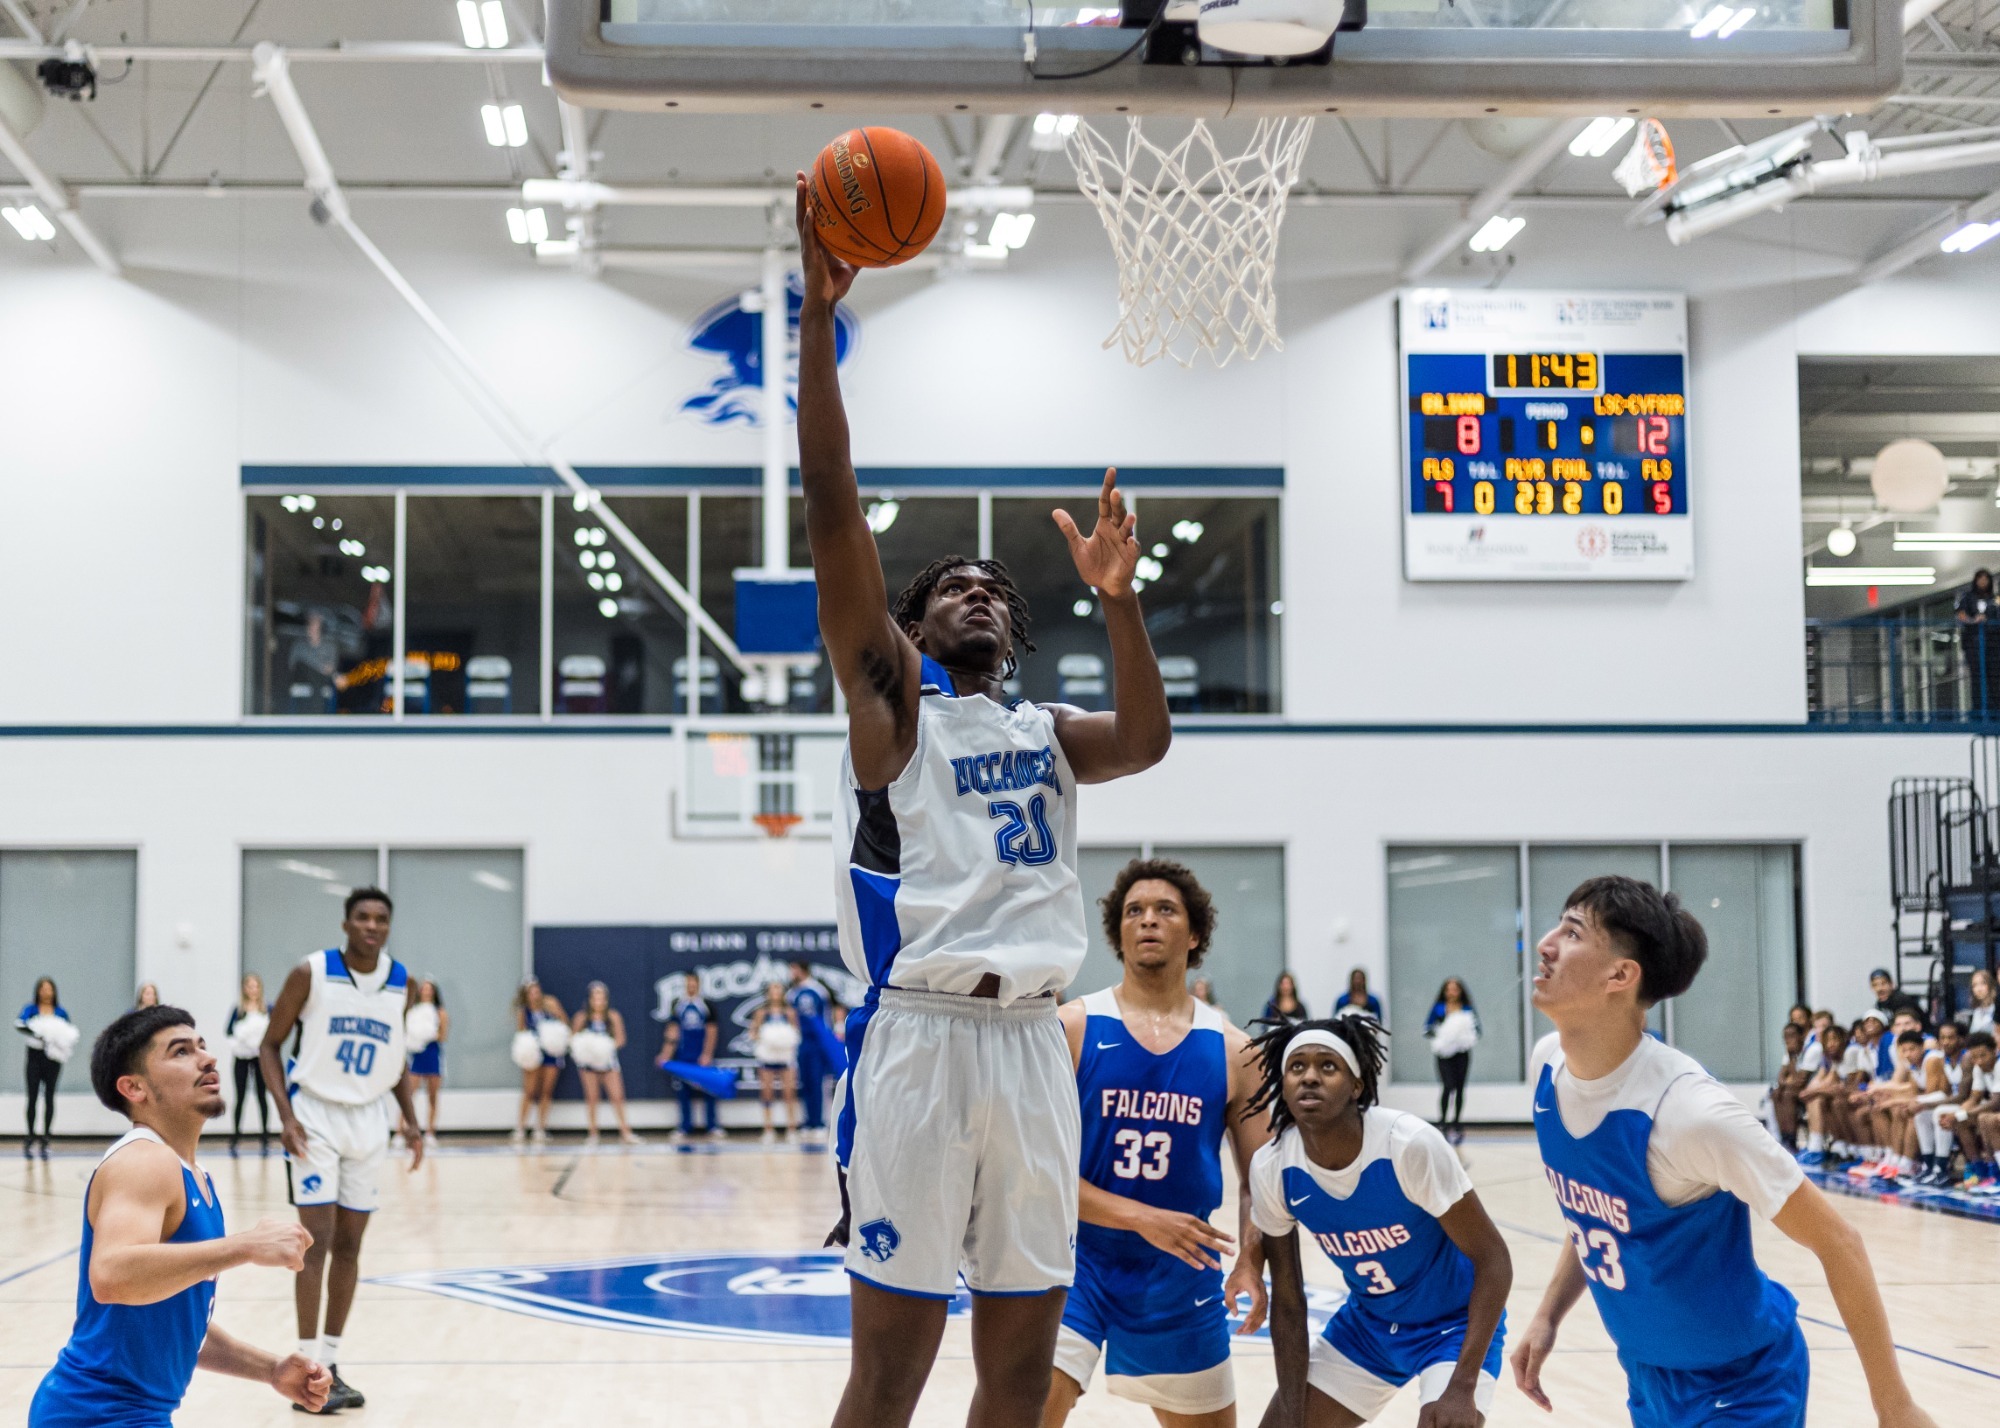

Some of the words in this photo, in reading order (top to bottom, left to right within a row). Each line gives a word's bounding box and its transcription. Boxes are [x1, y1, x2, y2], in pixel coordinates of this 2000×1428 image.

[1507, 352, 1597, 390] 11:43
[1457, 415, 1480, 455] 8
[1547, 420, 1557, 450] 1
[1637, 416, 1670, 455] 12
[1422, 457, 1455, 481] FLS
[1505, 457, 1545, 481] PLYR
[1552, 457, 1592, 481] FOUL
[1641, 457, 1673, 481] FLS
[1435, 481, 1454, 513] 7
[1474, 481, 1495, 515] 0
[1514, 481, 1554, 515] 23
[1562, 481, 1582, 515] 2
[1603, 481, 1623, 515] 0
[1652, 481, 1672, 514] 5
[670, 931, 747, 952] BLINN
[335, 1039, 376, 1076] 40
[1101, 1088, 1203, 1126] FALCONS
[1113, 1128, 1172, 1180] 33
[1545, 1166, 1631, 1233] ALCONS
[1313, 1223, 1411, 1256] ALCONS
[1565, 1217, 1626, 1291] 23
[1355, 1260, 1397, 1294] 3
